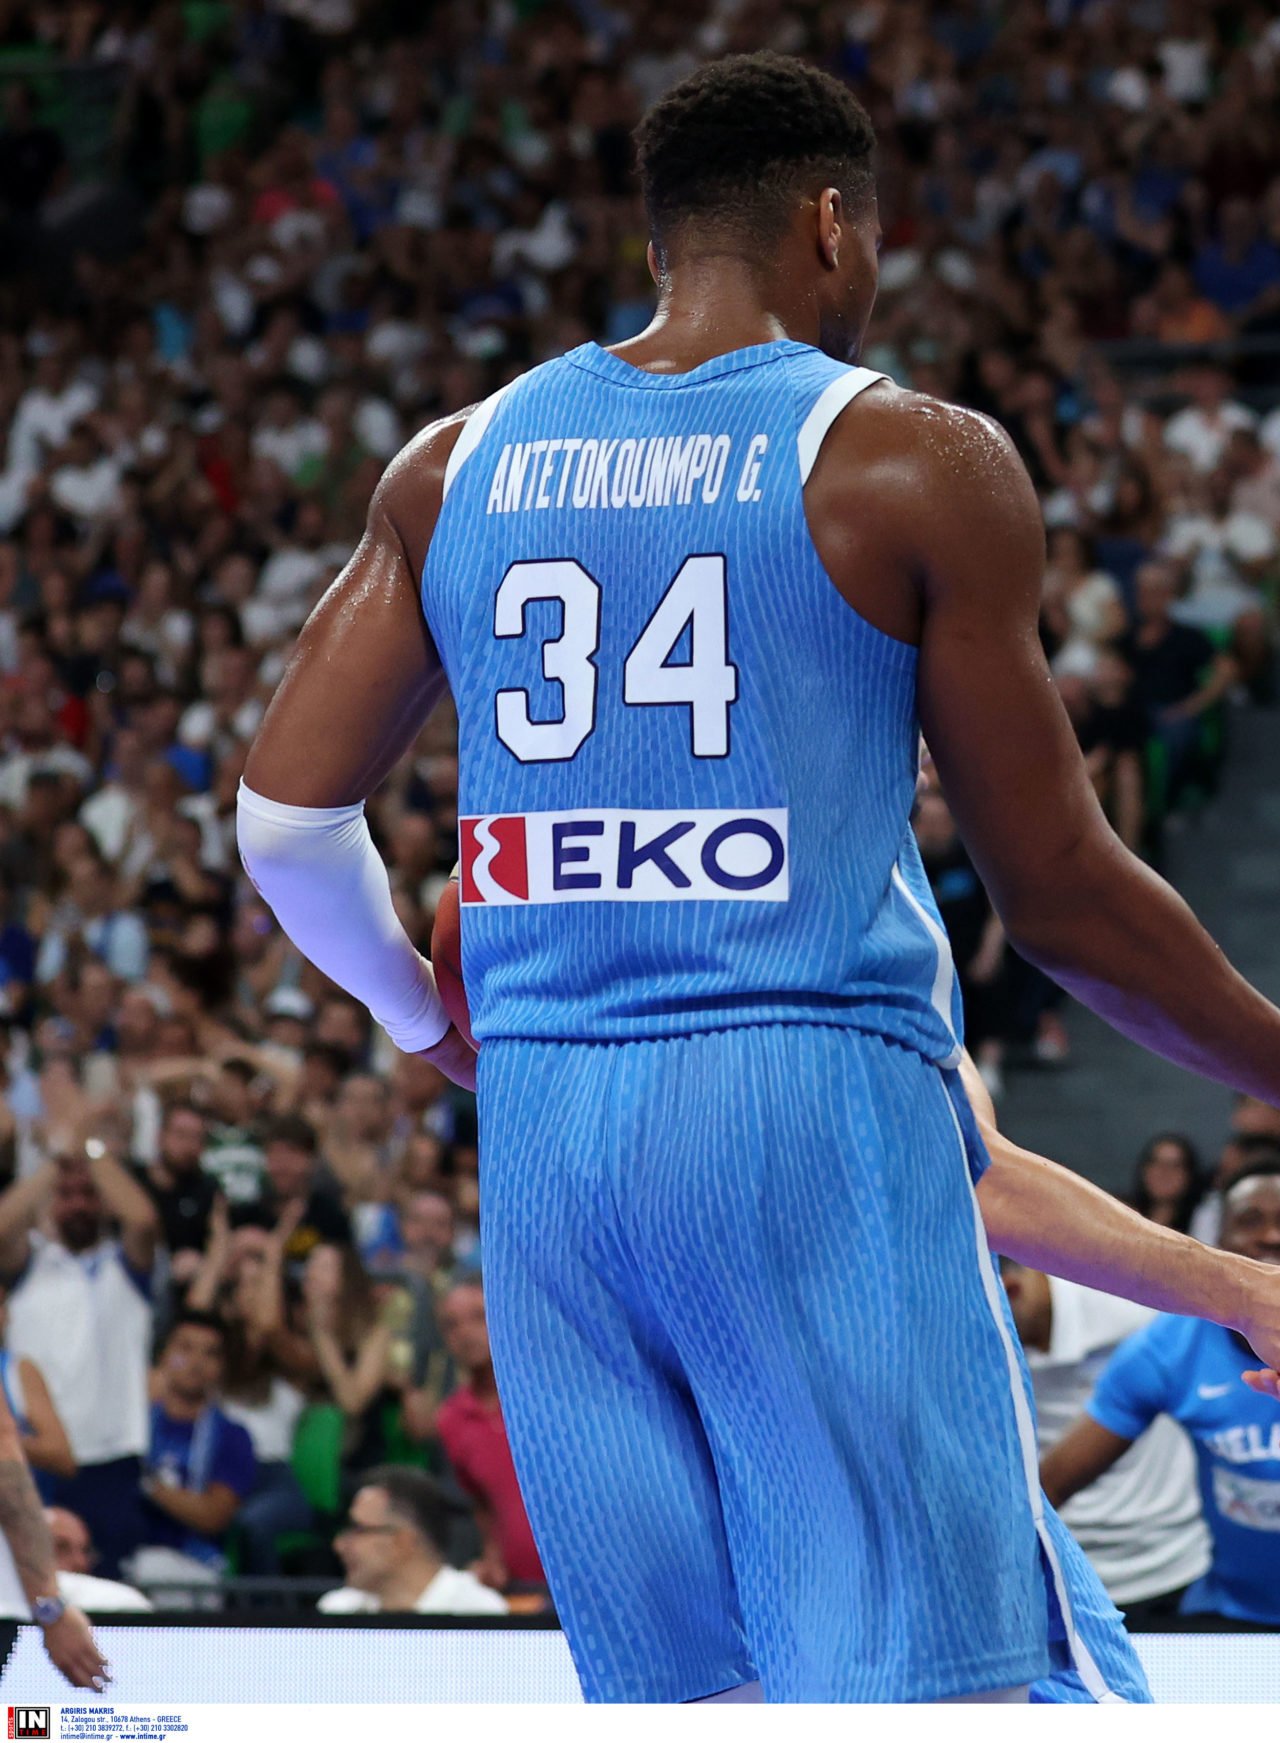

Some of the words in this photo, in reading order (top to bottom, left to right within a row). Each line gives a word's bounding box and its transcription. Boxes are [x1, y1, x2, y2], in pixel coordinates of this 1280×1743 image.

[486, 433, 732, 515] ANTETOKOUNMPO
[736, 433, 769, 503] G.
[493, 552, 739, 764] 34
[552, 818, 785, 891] EKO
